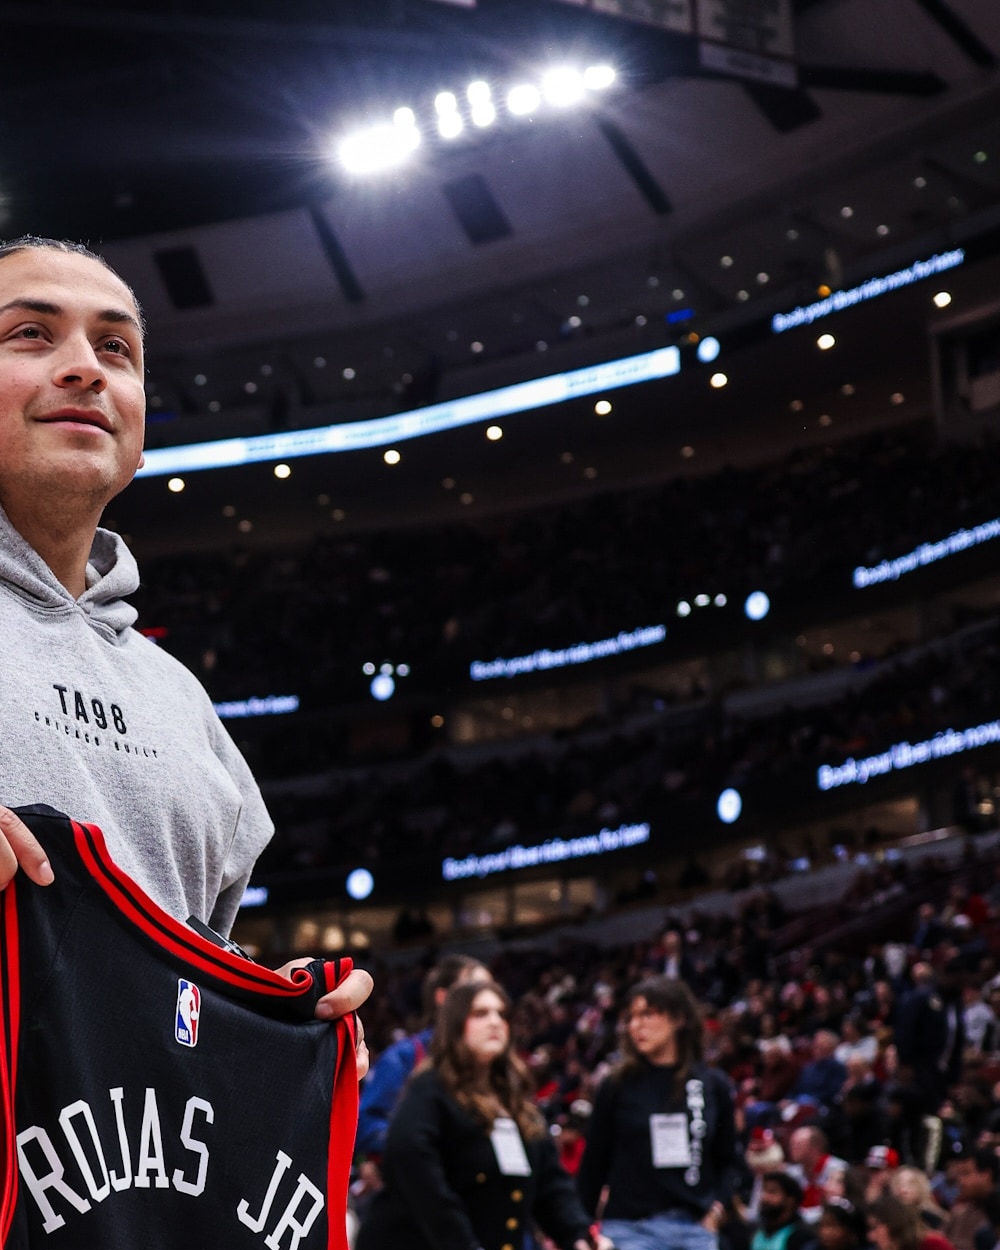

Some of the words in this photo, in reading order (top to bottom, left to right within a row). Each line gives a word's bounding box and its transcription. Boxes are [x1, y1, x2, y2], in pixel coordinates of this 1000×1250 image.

[34, 711, 100, 747] CHICAGO
[114, 741, 158, 759] BUILT
[52, 684, 127, 735] TA98
[818, 758, 856, 790] Book
[857, 747, 892, 781] your
[932, 728, 964, 757] ride
[178, 1028, 189, 1042] NBA
[16, 1086, 214, 1234] ROJAS
